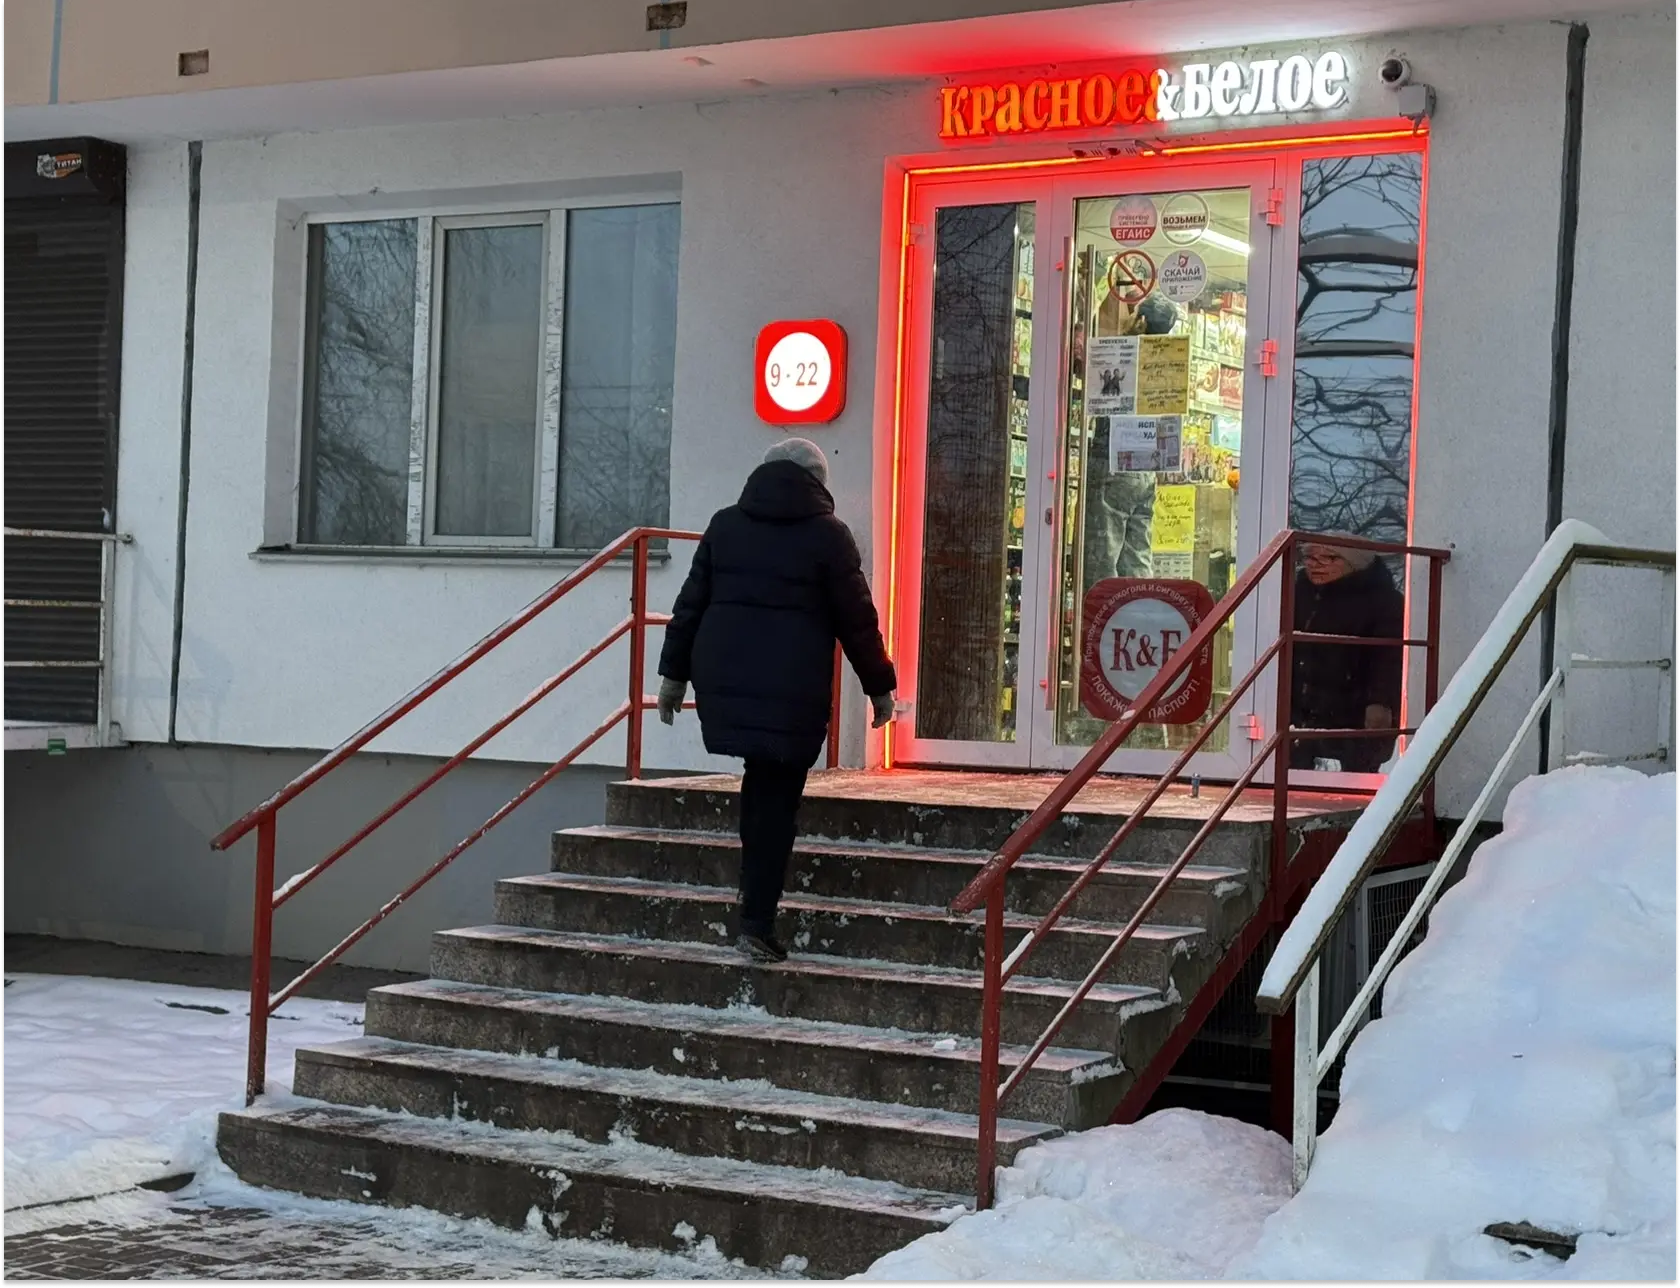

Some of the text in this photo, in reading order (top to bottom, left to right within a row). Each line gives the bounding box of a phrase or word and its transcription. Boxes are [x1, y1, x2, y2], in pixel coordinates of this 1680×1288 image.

[56, 158, 83, 169] ТИТАН
[1162, 215, 1206, 225] ВОЗЬМЕМ
[1115, 228, 1151, 239] ЕГАИС
[1164, 266, 1200, 277] СКАЧАЙ
[1161, 275, 1203, 283] ПРИЛОЖЕНИЕ
[1138, 421, 1156, 429] ИСП
[1109, 583, 1147, 607] алкоголя
[1148, 679, 1201, 719] ПАСПОРТ!
